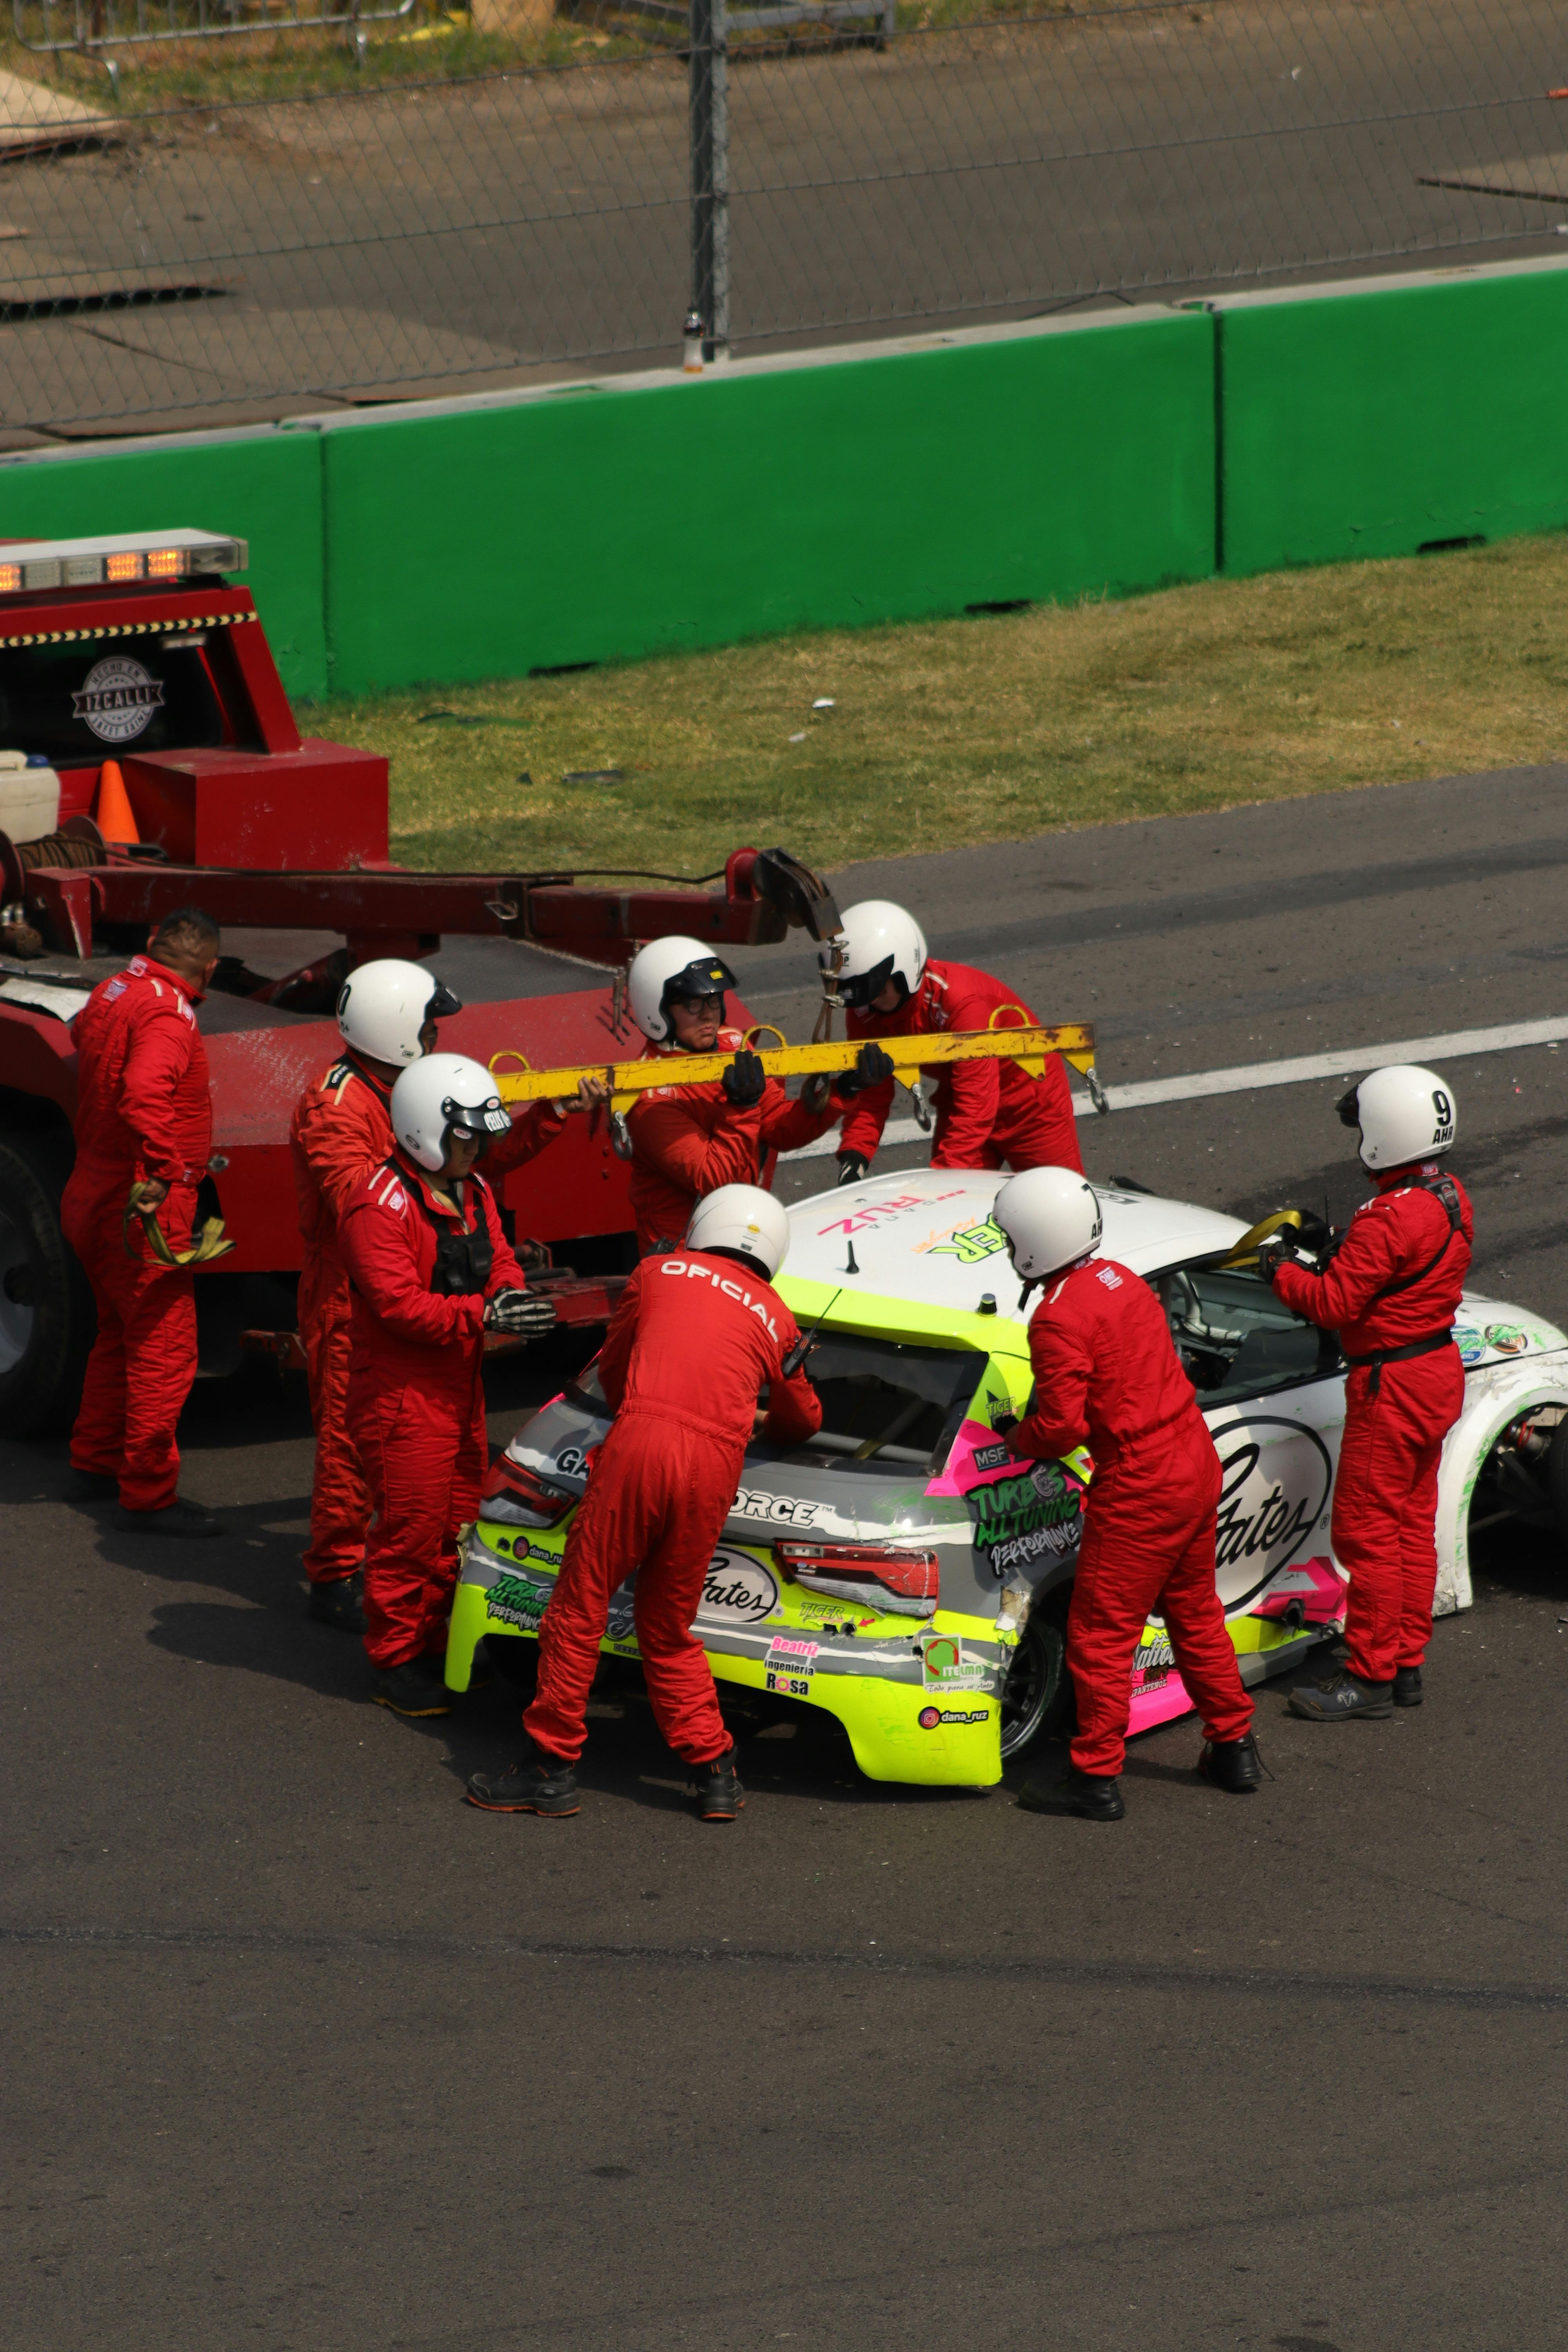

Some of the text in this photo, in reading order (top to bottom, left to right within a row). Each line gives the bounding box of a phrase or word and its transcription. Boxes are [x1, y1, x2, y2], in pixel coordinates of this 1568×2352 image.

[86, 688, 151, 711] IZCALLI
[1432, 1091, 1451, 1127] 9
[1432, 1126, 1453, 1145] AHR
[817, 1196, 925, 1236] RUZ
[1099, 1269, 1116, 1285] OMP
[661, 1260, 779, 1343] OFICIAL
[985, 1397, 1016, 1418] TIGER
[975, 1446, 1005, 1467] MSF
[976, 1493, 1080, 1547] ALL TUNING
[530, 1545, 563, 1564] dana_ru
[800, 1602, 844, 1620] TIGER
[941, 1711, 987, 1722] dana_ruz
